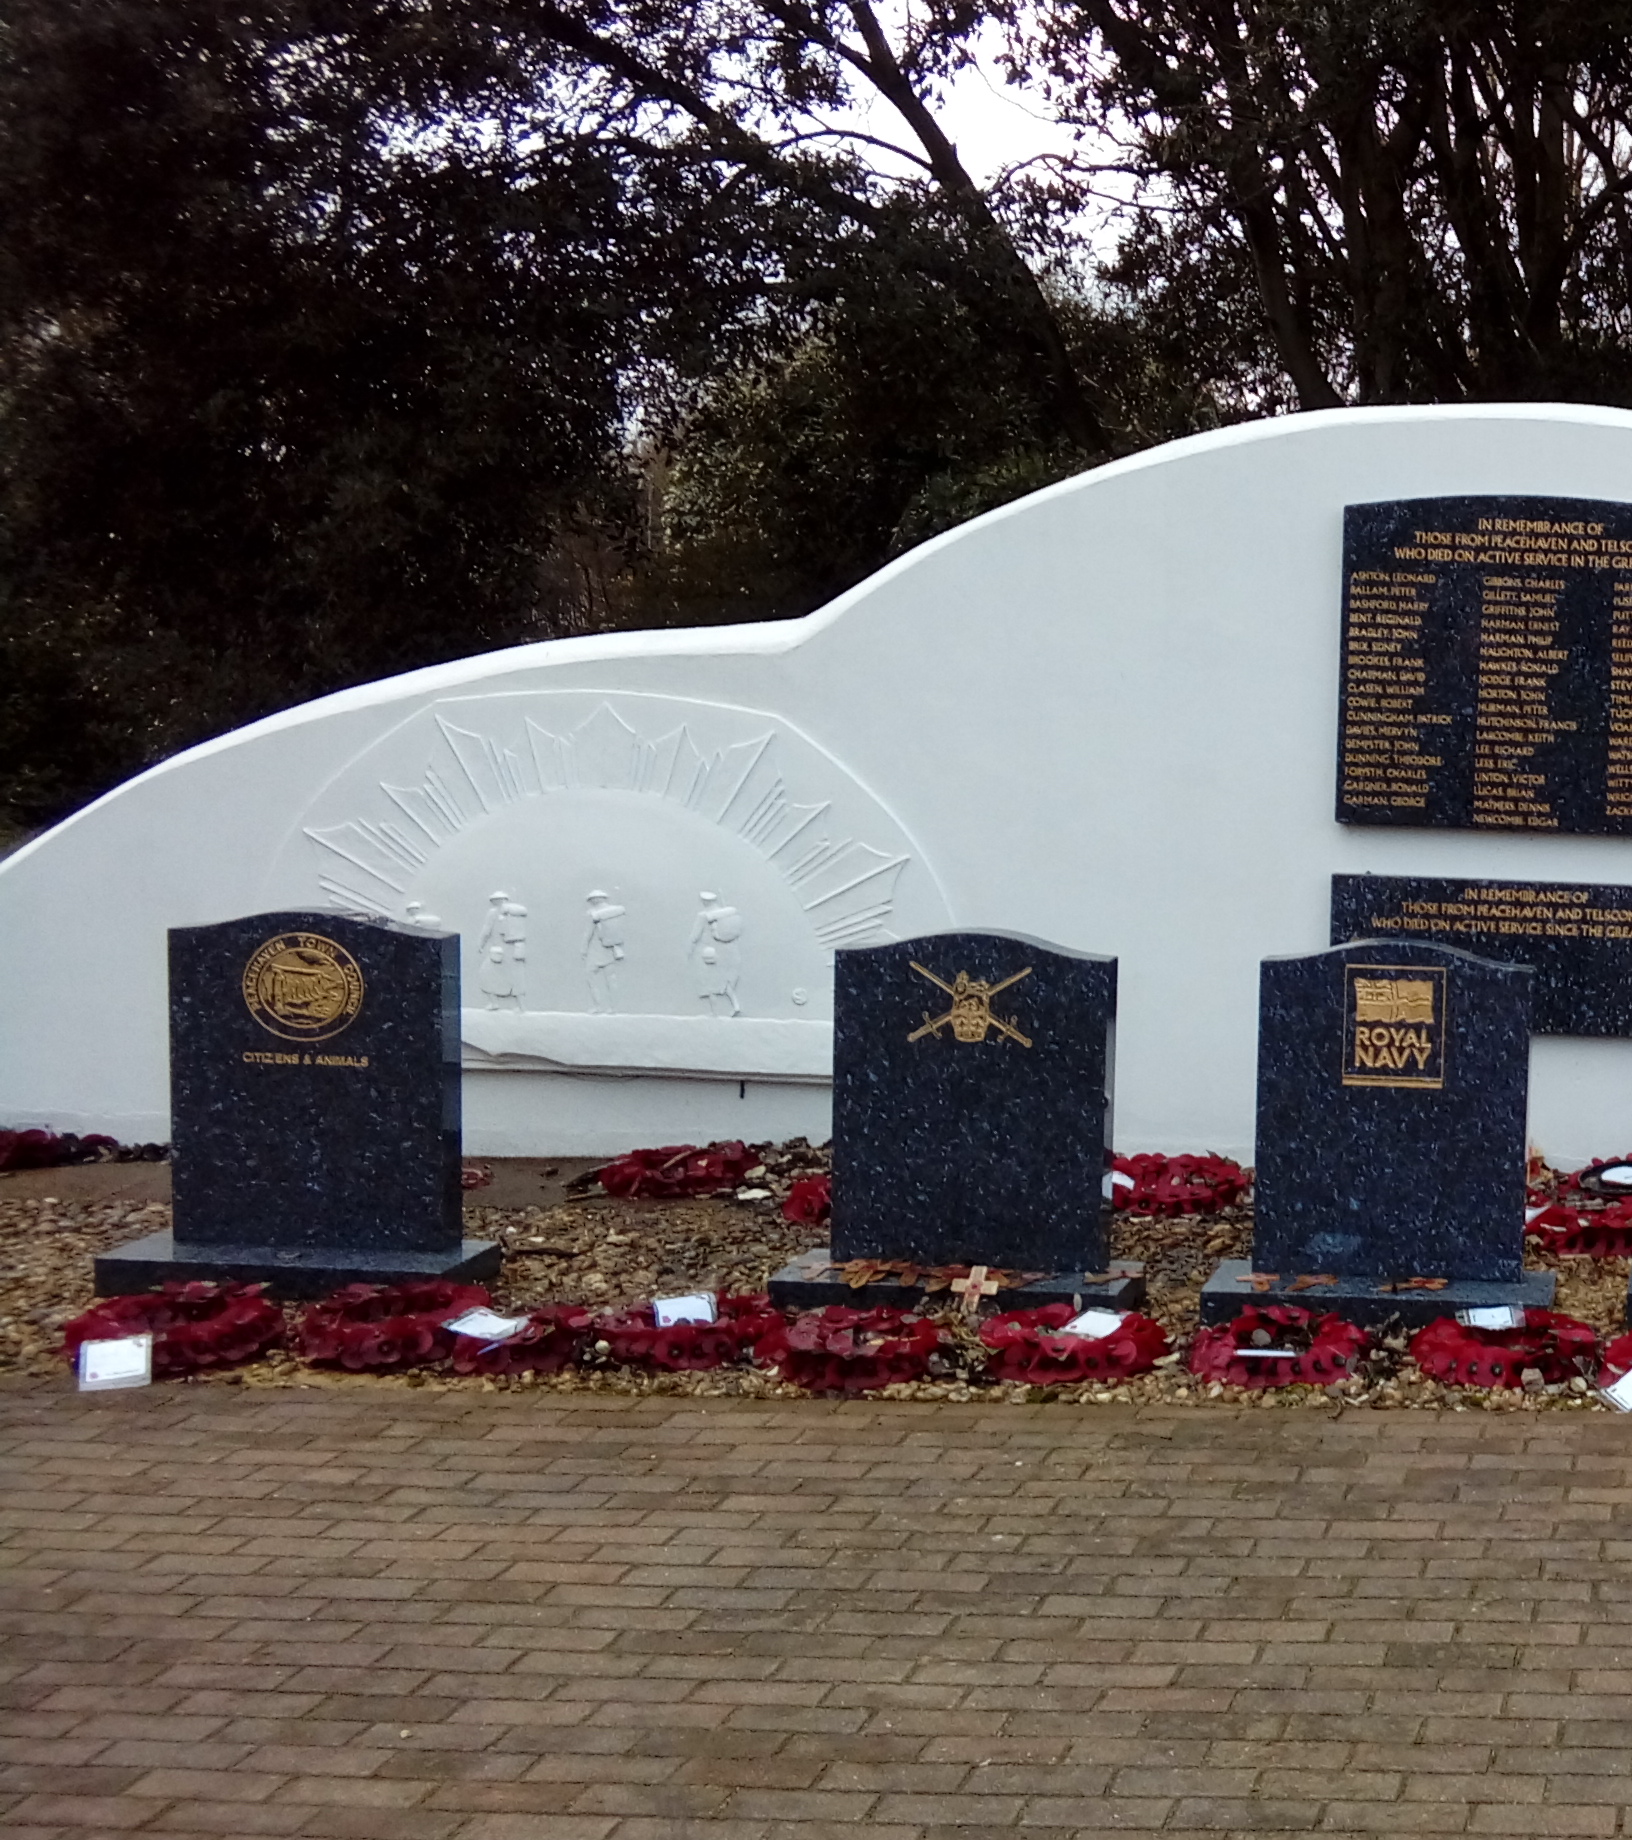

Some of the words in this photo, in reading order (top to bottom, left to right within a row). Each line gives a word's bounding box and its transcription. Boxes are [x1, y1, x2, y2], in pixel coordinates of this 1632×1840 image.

[1478, 518, 1492, 531] IN
[1495, 518, 1585, 535] REMEMBRANCE
[1587, 523, 1604, 535] OF
[1415, 531, 1452, 545] THOSE
[1455, 533, 1489, 547] FROM
[1491, 535, 1568, 551] PEACEHAVEN
[1570, 539, 1597, 551] AND
[1394, 547, 1426, 560] WHO
[1427, 548, 1452, 561] DIED
[1454, 550, 1474, 563] ON
[1477, 551, 1521, 565] ACTIVE
[1523, 552, 1569, 567] SERVICE
[1571, 555, 1585, 567] IN
[1588, 555, 1609, 568] THE
[1392, 572, 1436, 584] LEONARD
[1524, 578, 1565, 590] CHARLES
[1520, 592, 1556, 603] SAMUEL
[1528, 607, 1555, 617] JOHN
[1392, 628, 1418, 639] JOHN
[1392, 656, 1425, 668] FRANK
[1514, 676, 1547, 687] FRANK
[1385, 684, 1425, 695] WILLIAM
[1520, 690, 1546, 701] JOHN
[1539, 719, 1577, 731] FRANCIS
[1394, 740, 1419, 751] JOHN
[1512, 773, 1545, 785] VICTOR
[1464, 888, 1478, 900] IN
[1480, 888, 1570, 903] REMEMBRANCE
[1573, 892, 1589, 904] OF
[1401, 901, 1438, 915] THOSE
[1441, 903, 1474, 917] FROM
[1477, 905, 1553, 920] PEACEHAVEN
[1556, 908, 1583, 921] AND
[1371, 917, 1401, 930] WHO
[1403, 917, 1429, 931] DIED
[1432, 919, 1449, 932] ON
[1453, 920, 1496, 933] ACTIVE
[1499, 921, 1543, 936] SERVICE
[1546, 923, 1577, 936] SINCE
[1581, 925, 1602, 937] THE
[298, 936, 336, 957] TOWN
[1355, 1026, 1432, 1048] ROYAL
[242, 1051, 299, 1064] CITIZENS
[315, 1055, 369, 1068] ANIMALS
[1354, 1046, 1431, 1070] NAVY
